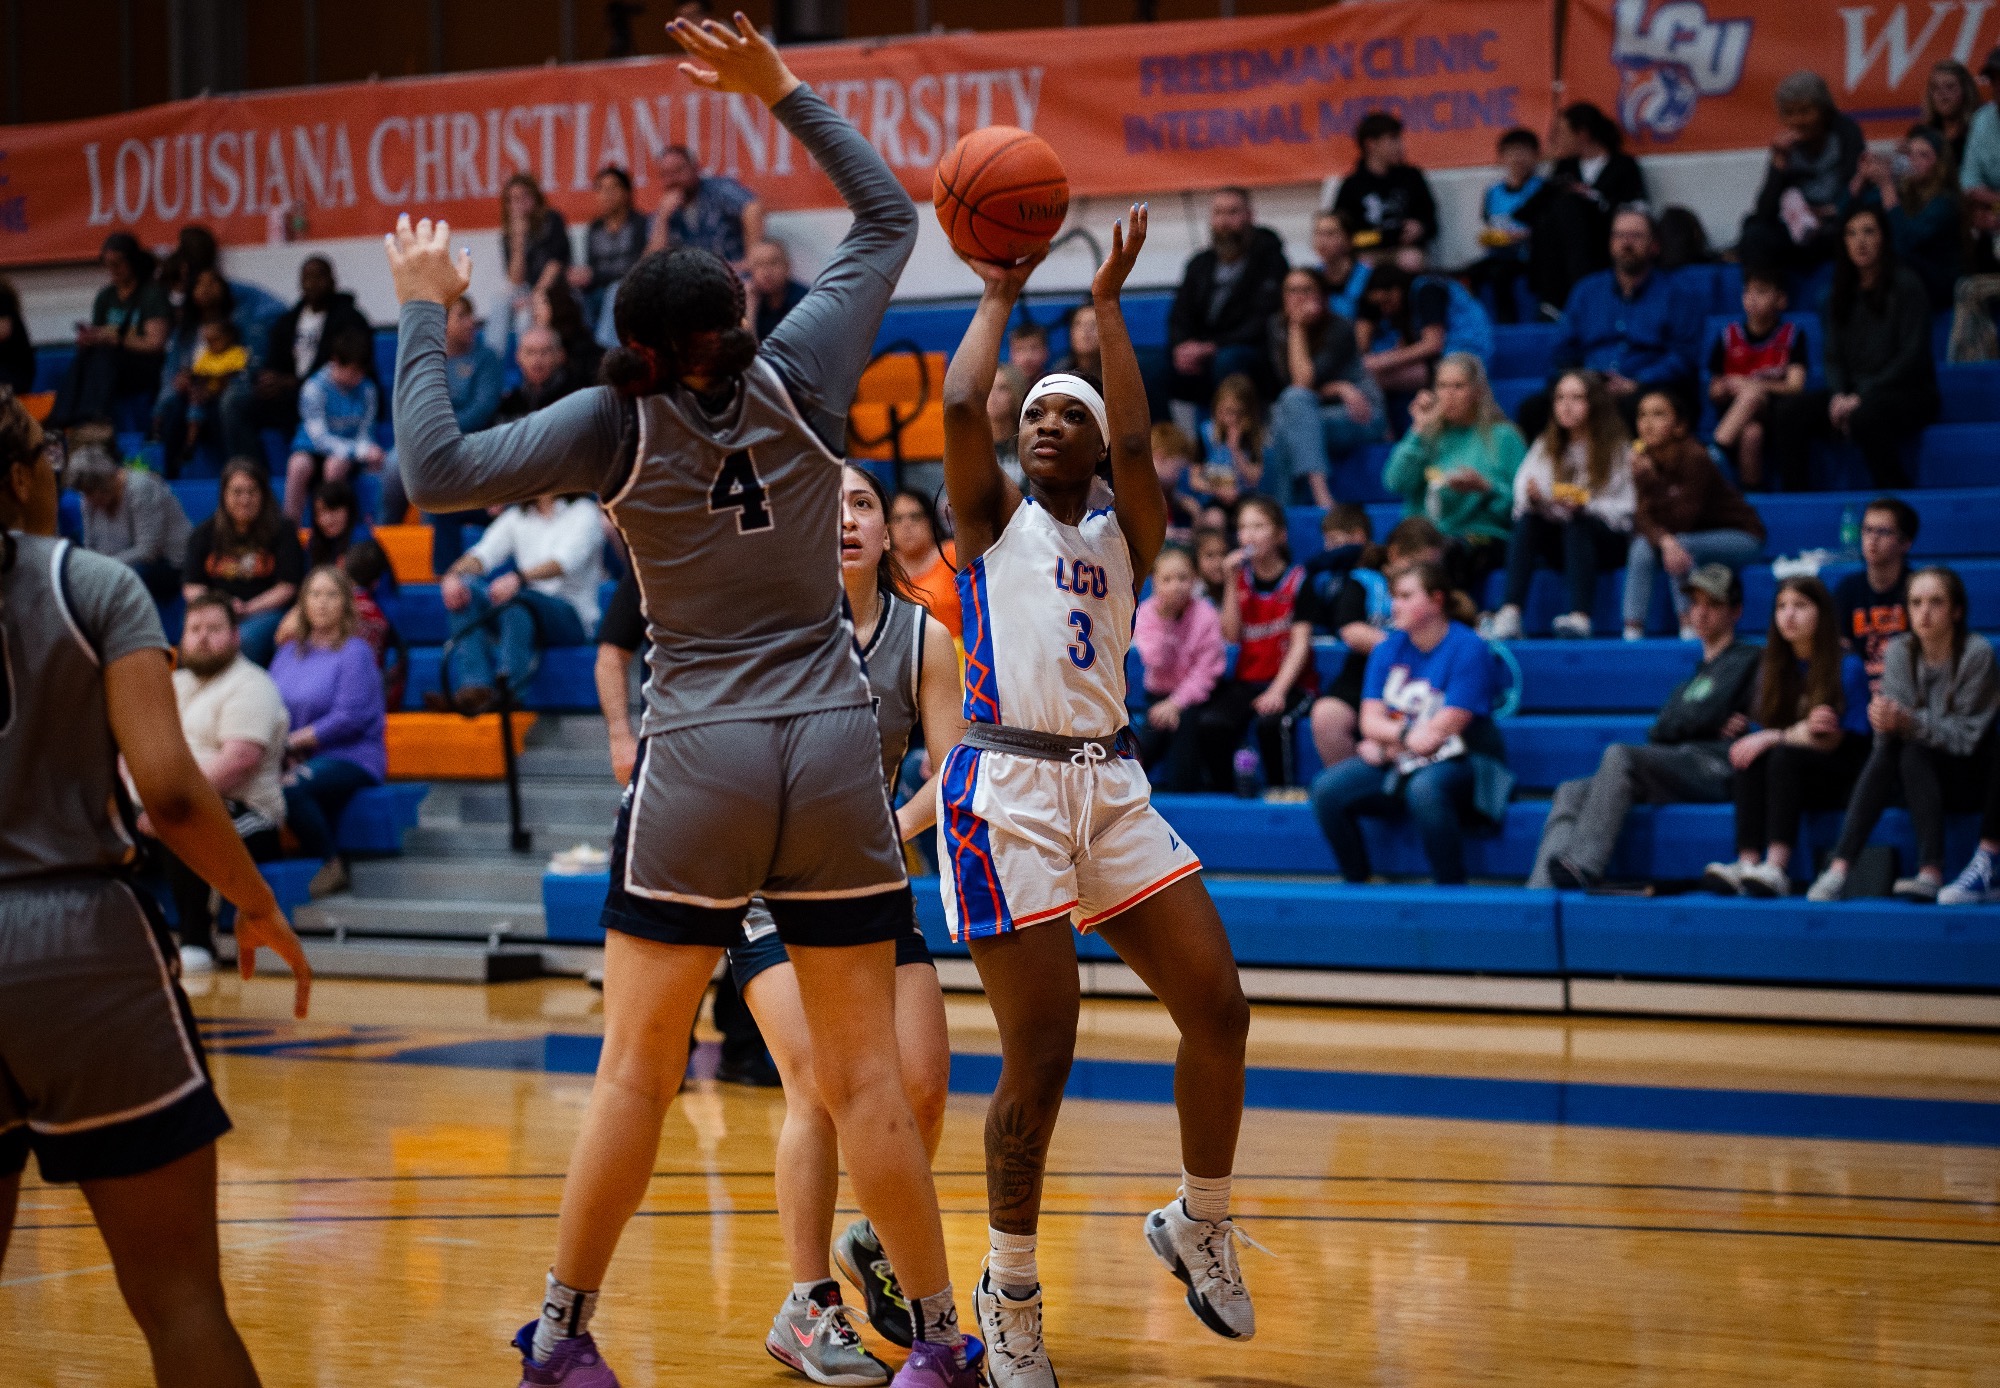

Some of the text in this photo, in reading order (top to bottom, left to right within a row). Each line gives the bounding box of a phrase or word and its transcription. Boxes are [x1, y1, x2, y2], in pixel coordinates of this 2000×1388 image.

[1141, 31, 1499, 97] FREEDMAN CLINIC
[1612, 0, 1754, 96] LCU
[84, 120, 357, 227] LOUISIANA
[367, 95, 673, 206] CHRISTIAN
[1123, 103, 1311, 155] INTERNAL
[707, 447, 774, 534] 4
[1055, 556, 1108, 600] LCU
[1067, 608, 1097, 671] 3
